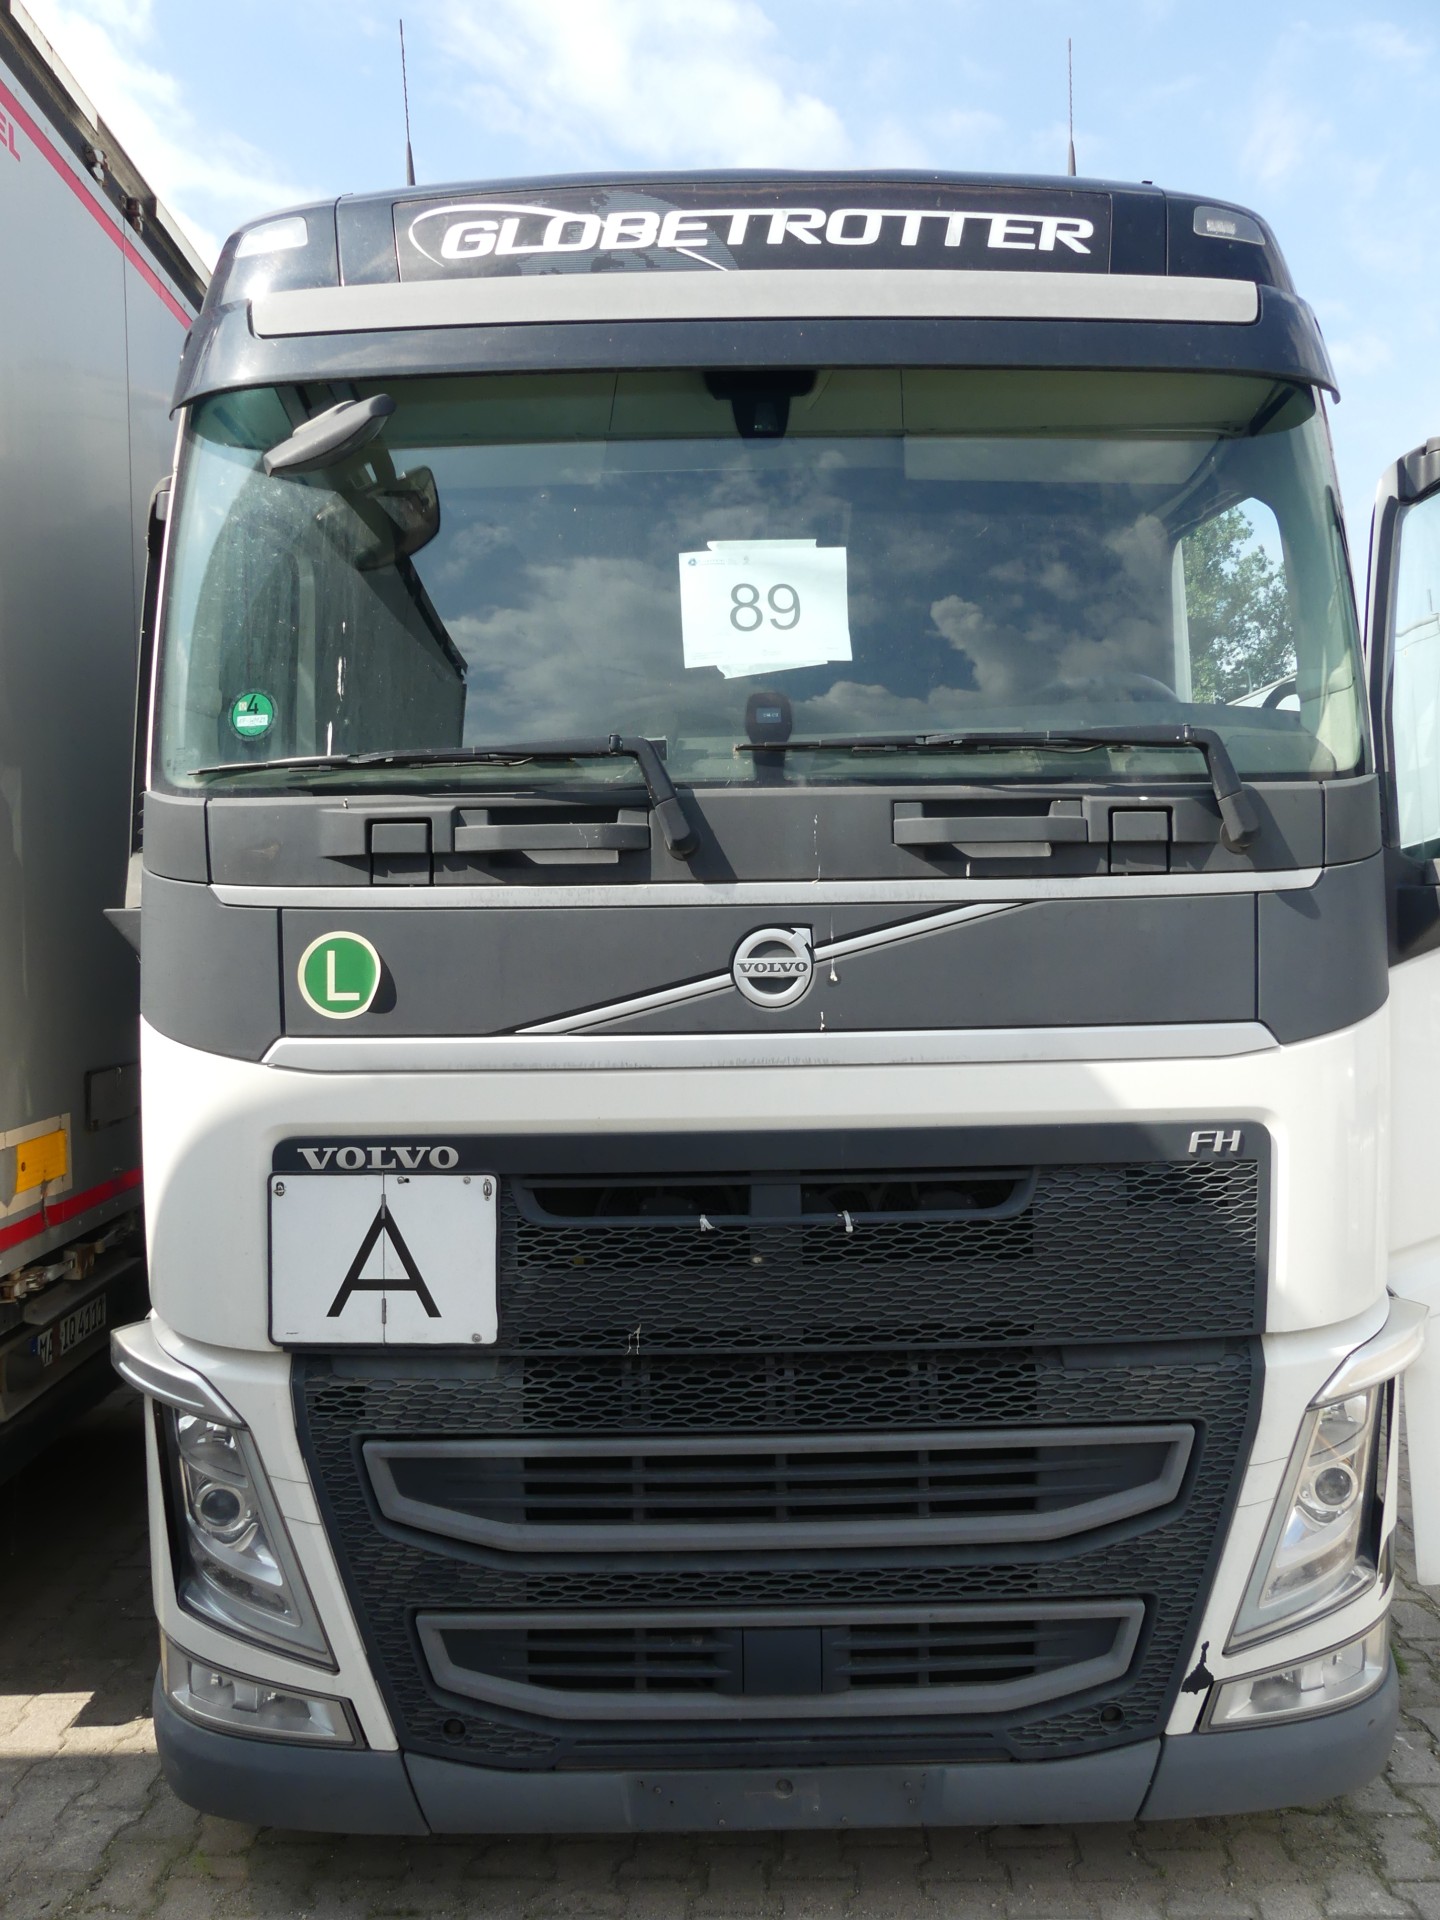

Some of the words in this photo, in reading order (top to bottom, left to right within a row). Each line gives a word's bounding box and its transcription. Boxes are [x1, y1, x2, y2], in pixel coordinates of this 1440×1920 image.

[441, 207, 1094, 259] GLOBETROTTER
[730, 582, 801, 632] 89
[246, 694, 259, 715] 4
[326, 950, 360, 1001] L
[737, 962, 808, 973] VOLVO
[297, 1146, 459, 1170] VOLVO
[1188, 1130, 1241, 1153] FH
[326, 1201, 442, 1318] A
